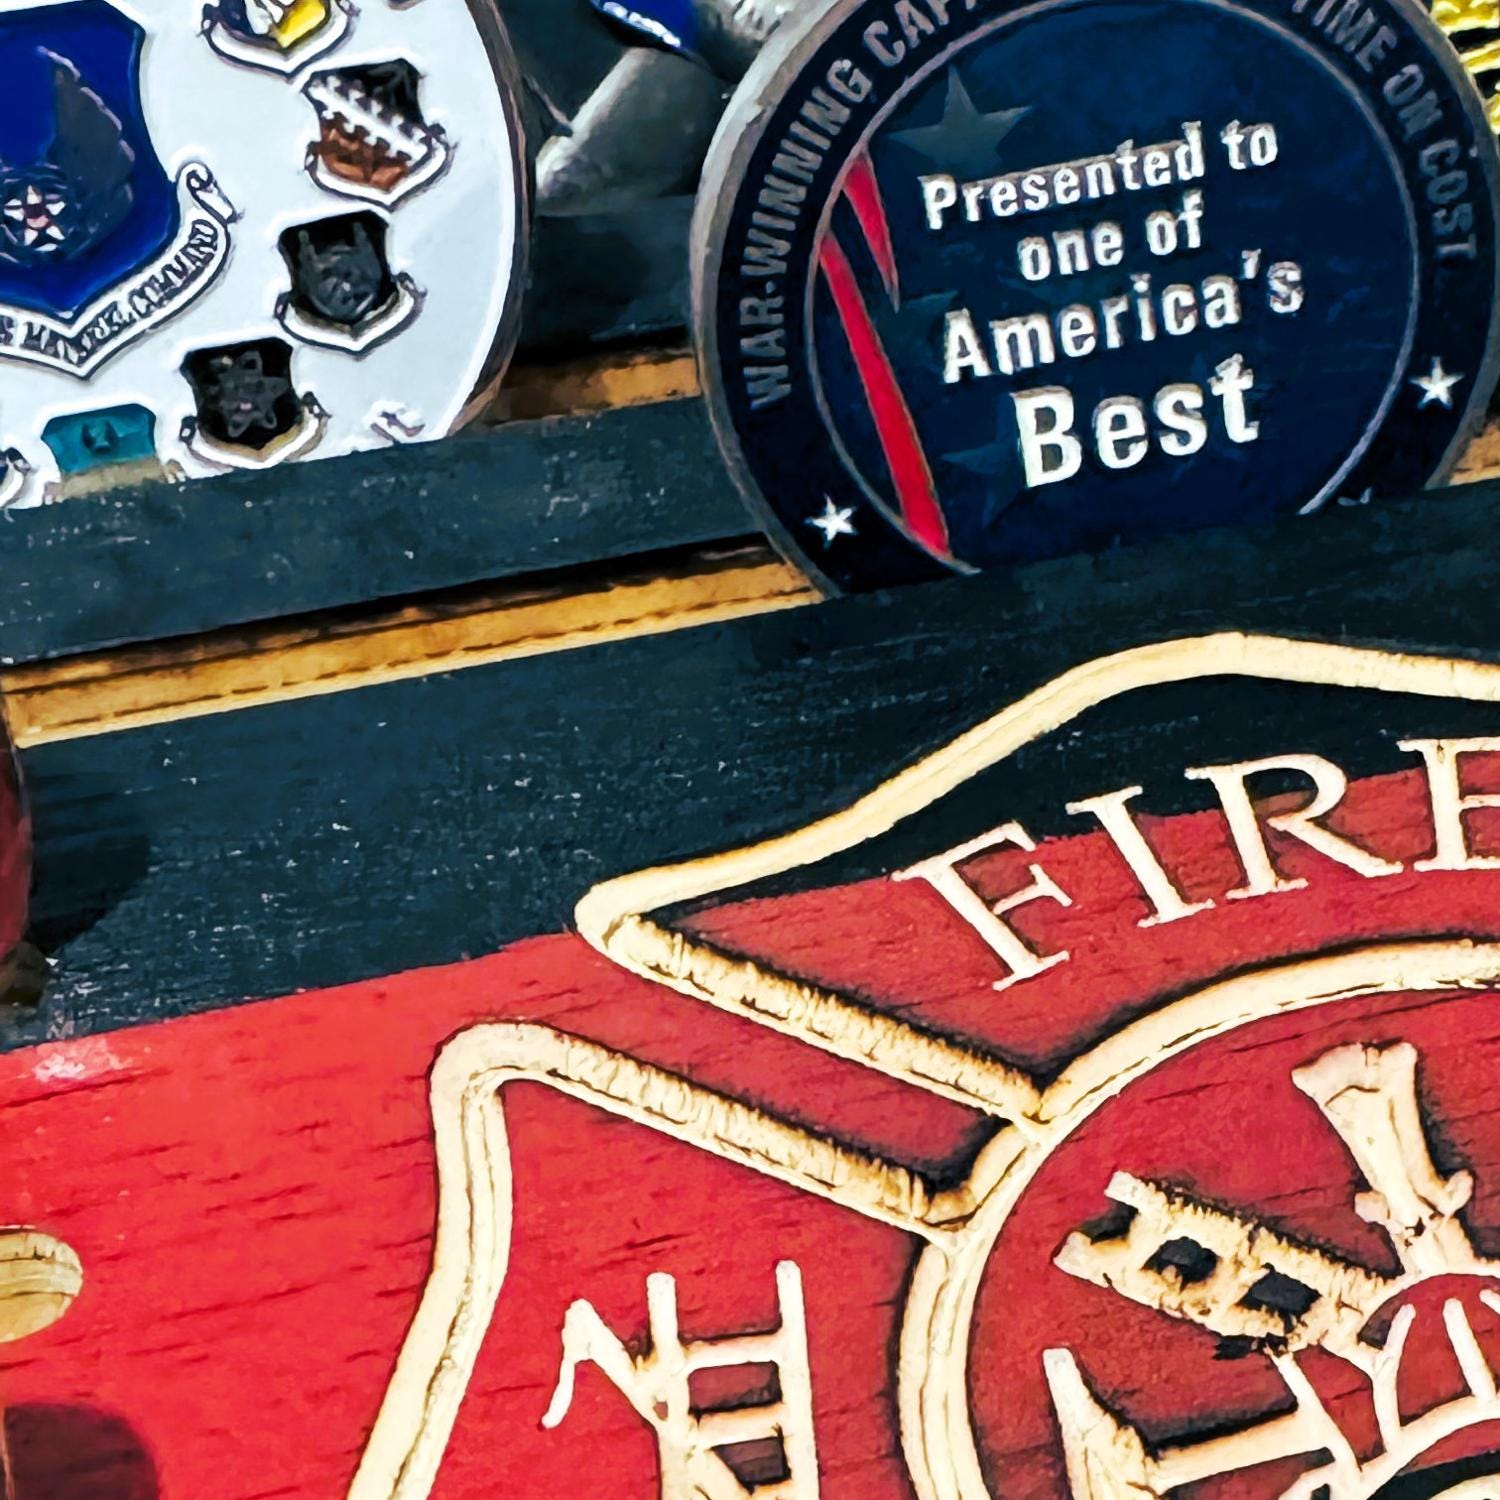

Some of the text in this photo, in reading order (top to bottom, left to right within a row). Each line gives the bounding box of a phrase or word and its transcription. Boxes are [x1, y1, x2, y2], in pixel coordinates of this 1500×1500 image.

[919, 119, 1278, 230] Presented to
[1383, 63, 1443, 141] ON
[1418, 138, 1477, 259] COST
[1017, 188, 1204, 281] one of
[943, 249, 1304, 384] America's
[1010, 353, 1260, 488] Best
